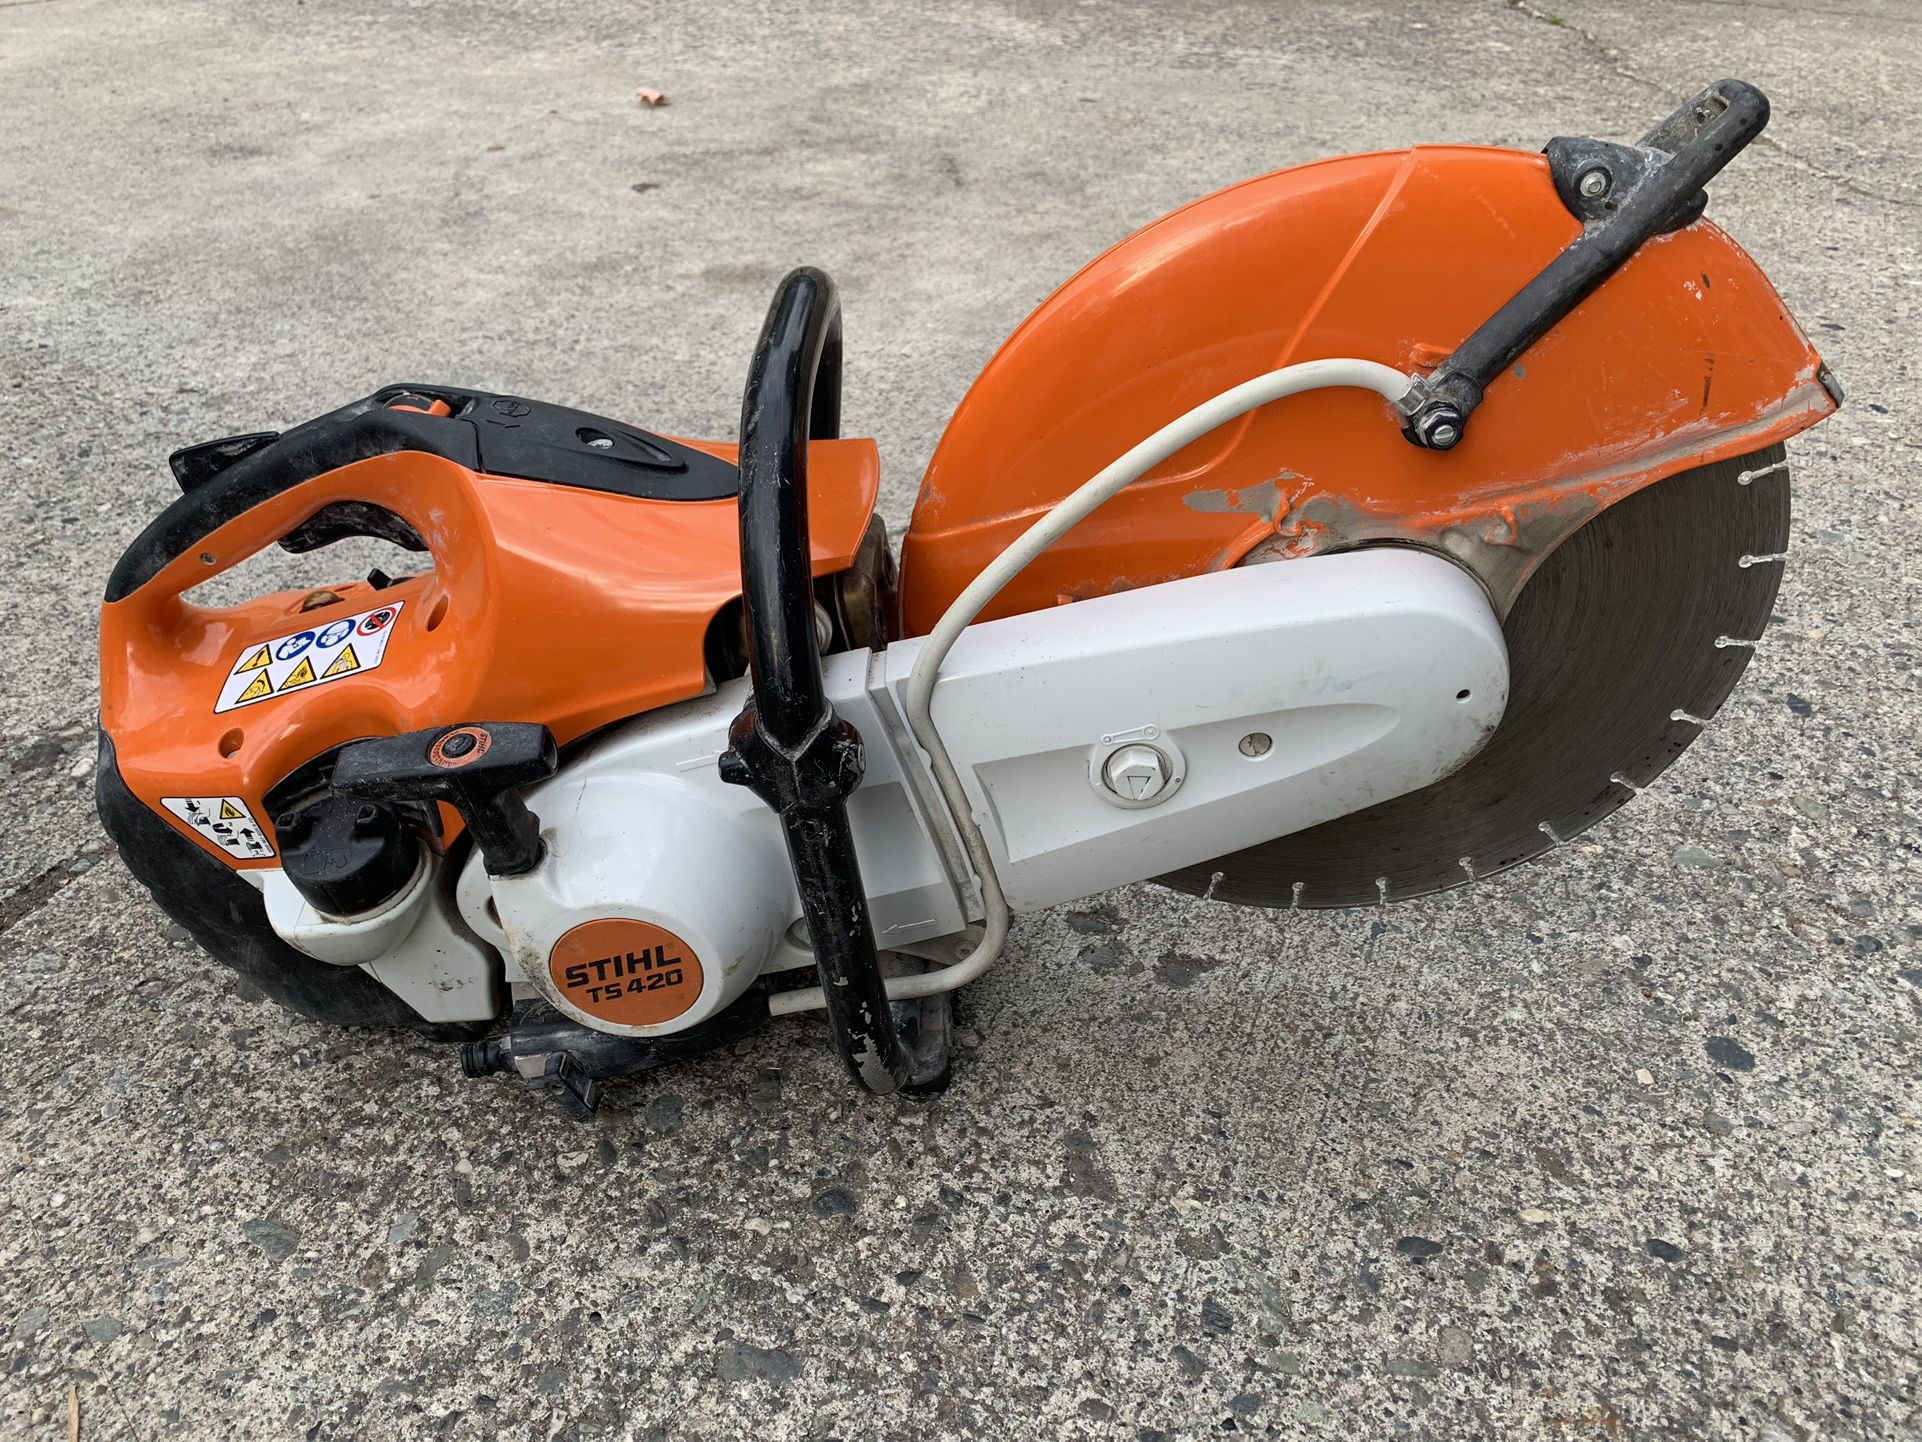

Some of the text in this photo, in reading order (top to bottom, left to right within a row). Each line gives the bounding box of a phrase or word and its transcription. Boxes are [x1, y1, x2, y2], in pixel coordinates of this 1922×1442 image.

[478, 732, 488, 754] STIHL
[565, 945, 682, 988] STIHL
[586, 968, 683, 1003] TS 420
